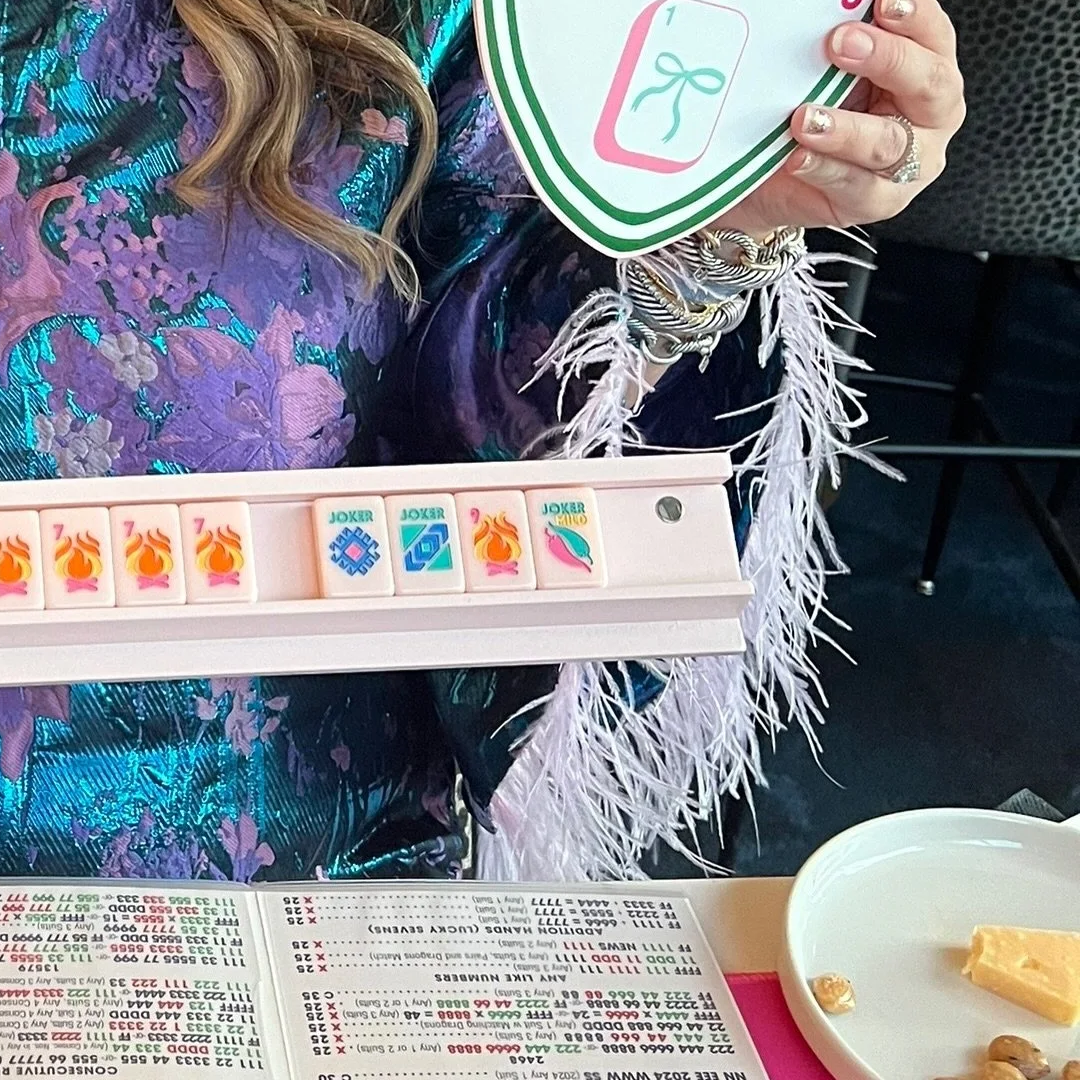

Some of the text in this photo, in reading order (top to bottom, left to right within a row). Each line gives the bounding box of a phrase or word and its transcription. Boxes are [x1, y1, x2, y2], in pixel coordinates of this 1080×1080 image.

[665, 5, 678, 27] 1
[542, 502, 586, 515] JOKER
[329, 509, 374, 524] JOKER
[400, 507, 446, 521] JOKER
[123, 521, 135, 537] 7
[193, 518, 205, 534] 7
[53, 524, 65, 540] 7
[368, 924, 602, 935] ADDITION HANDS (LUCKY SEVENS)
[292, 941, 308, 949] 25
[563, 942, 594, 950] 1111
[598, 942, 636, 951] NEWS
[642, 944, 673, 952] 1111
[678, 944, 691, 952] FF
[10, 954, 42, 962] 5555
[48, 954, 63, 962] 33
[70, 954, 92, 962] 111
[113, 954, 138, 962] 999
[144, 955, 158, 963] 77
[163, 955, 196, 964] 5555
[201, 956, 216, 965] 33
[224, 958, 245, 967] 111
[294, 954, 311, 962] 25
[555, 954, 586, 962] 1111
[592, 955, 621, 963] DDD
[627, 955, 641, 963] 11
[646, 956, 676, 964] DDD
[681, 956, 696, 964] 11
[18, 964, 58, 972] 13579
[296, 965, 314, 973] 25
[580, 965, 602, 974] 111
[609, 966, 640, 974] 1111
[646, 966, 669, 974] 111
[674, 967, 701, 975] FFFF
[434, 974, 566, 982] ANY LIKE NUMBERS
[109, 1022, 144, 1030] 3333
[150, 1022, 166, 1031] 22
[186, 1023, 220, 1033] 3333
[227, 1025, 244, 1034] 22
[310, 1035, 328, 1044] 25
[564, 1033, 603, 1042] 8888
[610, 1033, 640, 1042] 666
[647, 1033, 666, 1042] 44
[674, 1034, 702, 1042] 444
[710, 1034, 730, 1042] 22
[313, 1044, 734, 1055] 222 444 6666 8888 222 444 6666 8888 X 25
[9, 1055, 43, 1064] 7777
[49, 1055, 66, 1064] 66
[72, 1055, 97, 1064] 555
[121, 1055, 146, 1064] 555
[152, 1056, 169, 1064] 44
[176, 1056, 209, 1066] 3333
[216, 1058, 232, 1067] 22
[509, 1056, 544, 1064] 2468
[240, 1060, 263, 1070] 111
[16, 1066, 117, 1075] CONSECUTIVE
[584, 1072, 746, 1080] NN EEE 2024 WWW SS
